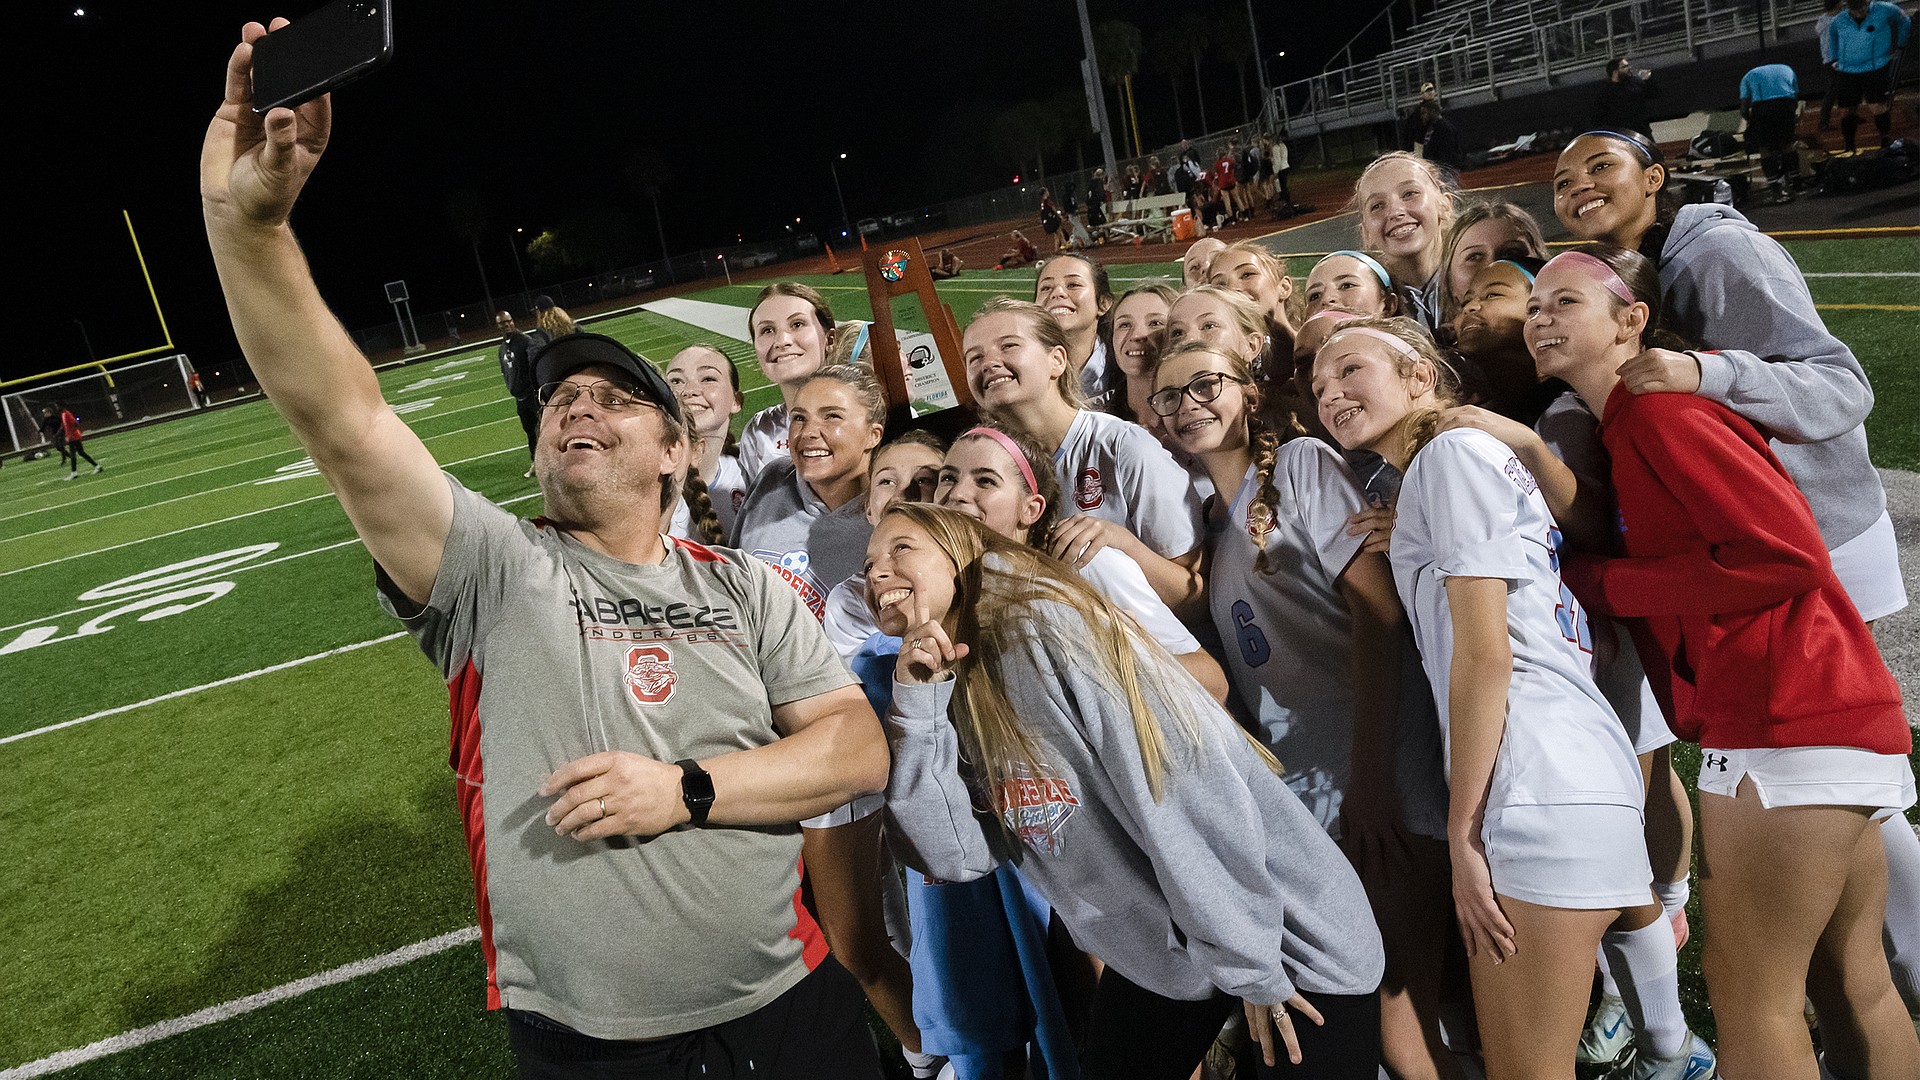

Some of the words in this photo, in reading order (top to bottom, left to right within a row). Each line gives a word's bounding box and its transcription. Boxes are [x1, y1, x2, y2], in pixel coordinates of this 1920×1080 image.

[1222, 161, 1230, 174] 7
[914, 377, 940, 388] CHAMPION
[926, 390, 948, 401] FLORIDA
[1231, 599, 1272, 669] 6
